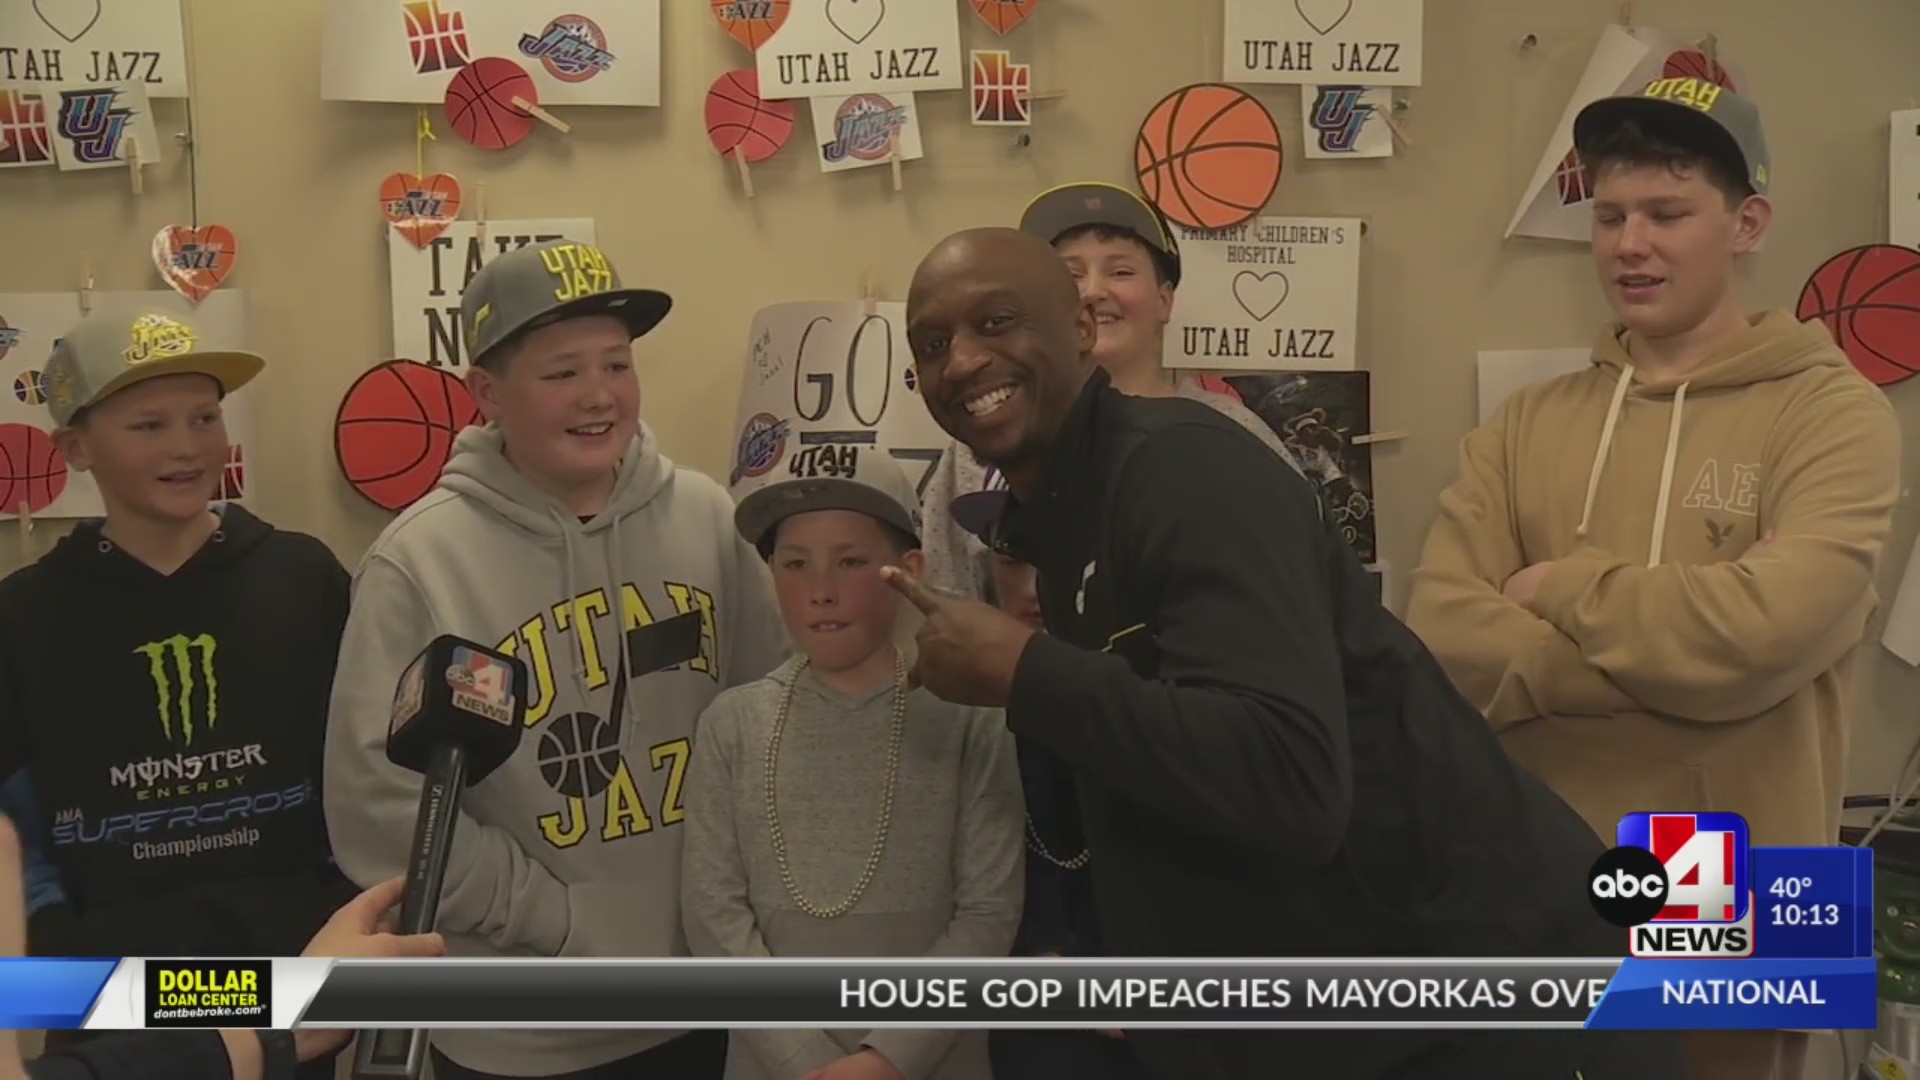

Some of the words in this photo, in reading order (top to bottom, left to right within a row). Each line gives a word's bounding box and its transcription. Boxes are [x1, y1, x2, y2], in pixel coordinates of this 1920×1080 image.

[86, 51, 163, 83] JAZZ
[777, 53, 851, 84] UTAH
[870, 47, 940, 79] JAZZ
[1244, 40, 1313, 70] UTAH
[1331, 43, 1400, 72] JAZZ
[1644, 77, 1722, 104] UTAH
[1258, 225, 1345, 244] CHILDREN'S
[429, 234, 564, 296] TA
[539, 244, 609, 274] UTAH
[1227, 245, 1296, 264] HOSPITAL
[555, 268, 613, 301] JAZZ
[1183, 326, 1250, 357] UTAH
[1267, 328, 1335, 358] JAZZ
[793, 314, 892, 426] GO
[789, 444, 859, 478] UTAH
[1682, 458, 1760, 516] AE
[456, 694, 510, 722] NEWS
[110, 743, 268, 788] MONSTER
[136, 774, 246, 801] ENERGY
[52, 779, 314, 845] SUPERCROS
[55, 807, 84, 825] AMA
[132, 826, 260, 860] Championship
